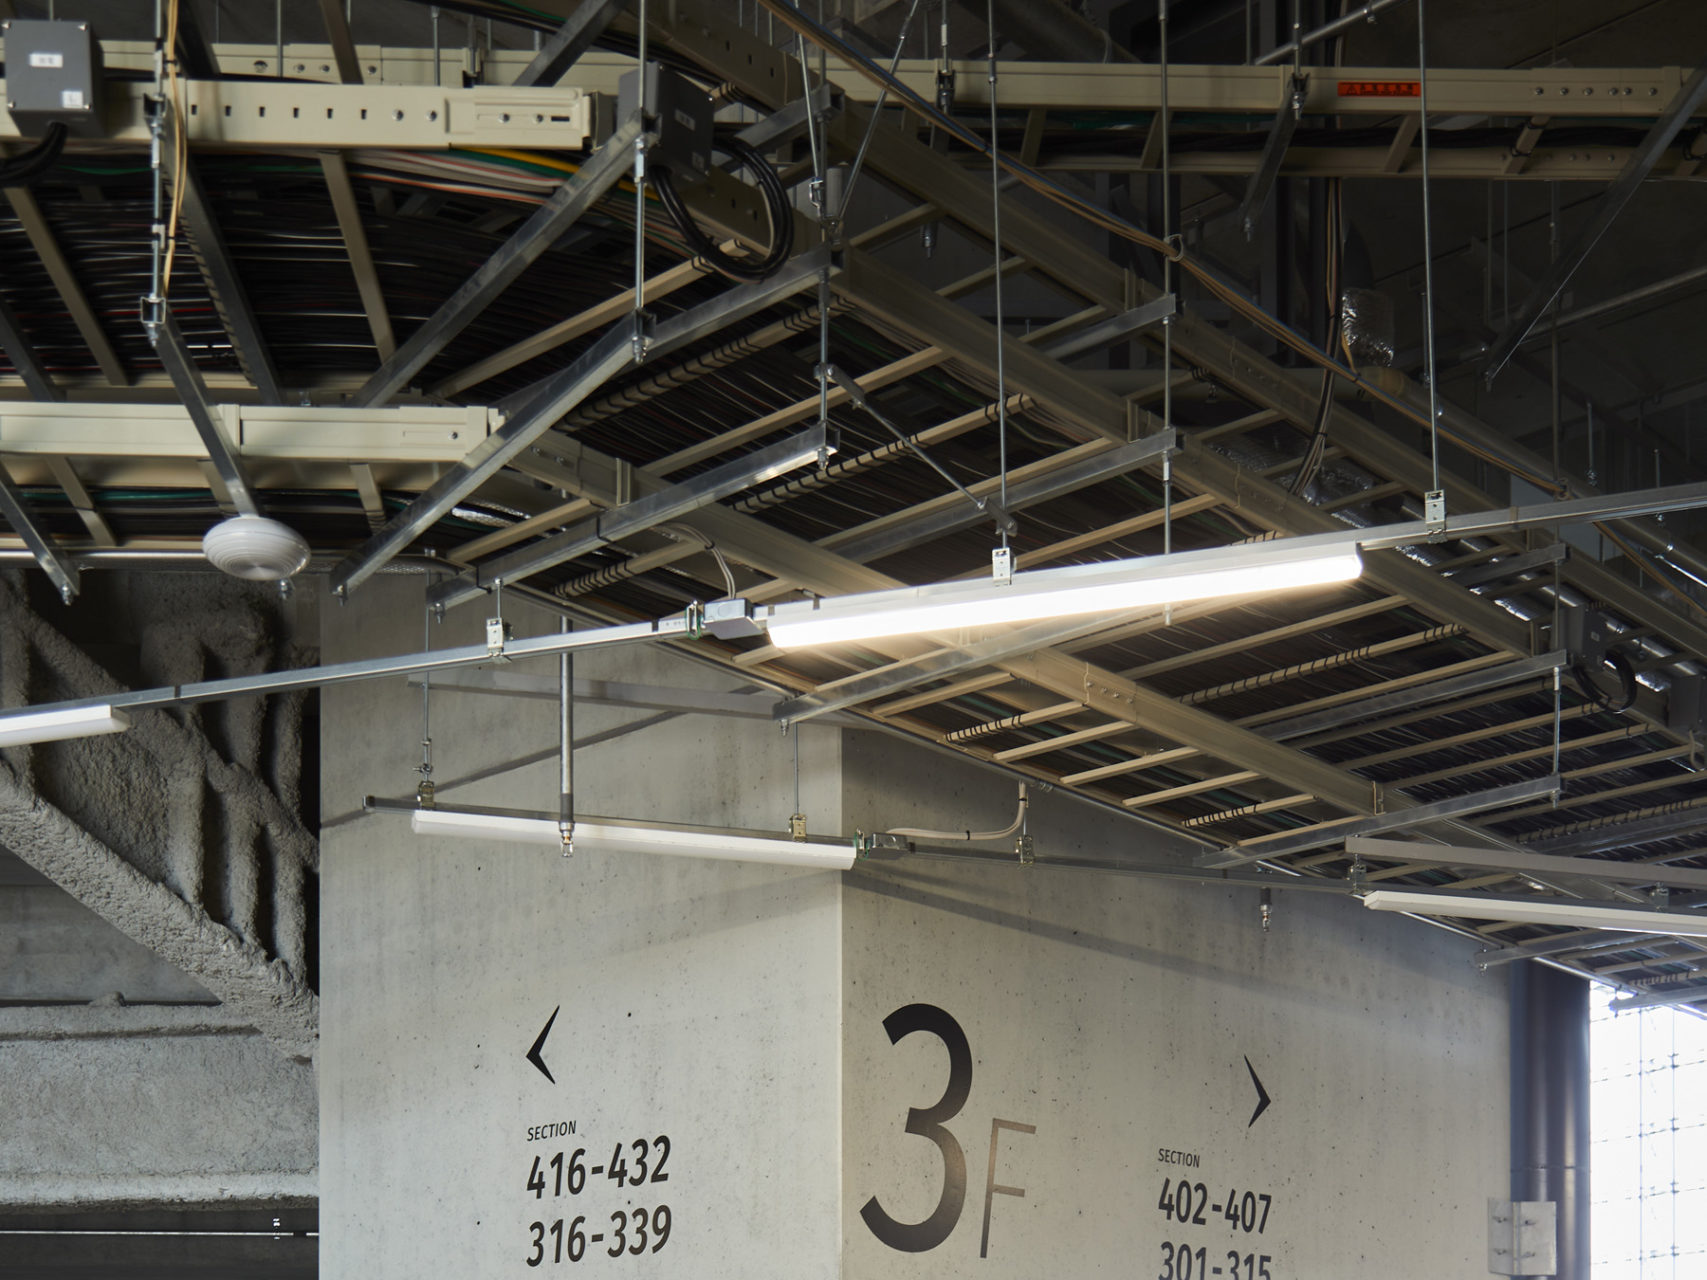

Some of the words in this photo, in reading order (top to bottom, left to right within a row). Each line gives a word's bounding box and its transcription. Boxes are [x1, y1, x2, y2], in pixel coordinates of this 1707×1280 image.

[526, 1121, 577, 1142] SECTION
[859, 1003, 1037, 1259] 3F
[1158, 1149, 1201, 1169] SECTION
[526, 1135, 671, 1200] 416-432
[526, 1205, 672, 1268] 316-339
[1158, 1178, 1272, 1235] 402-407
